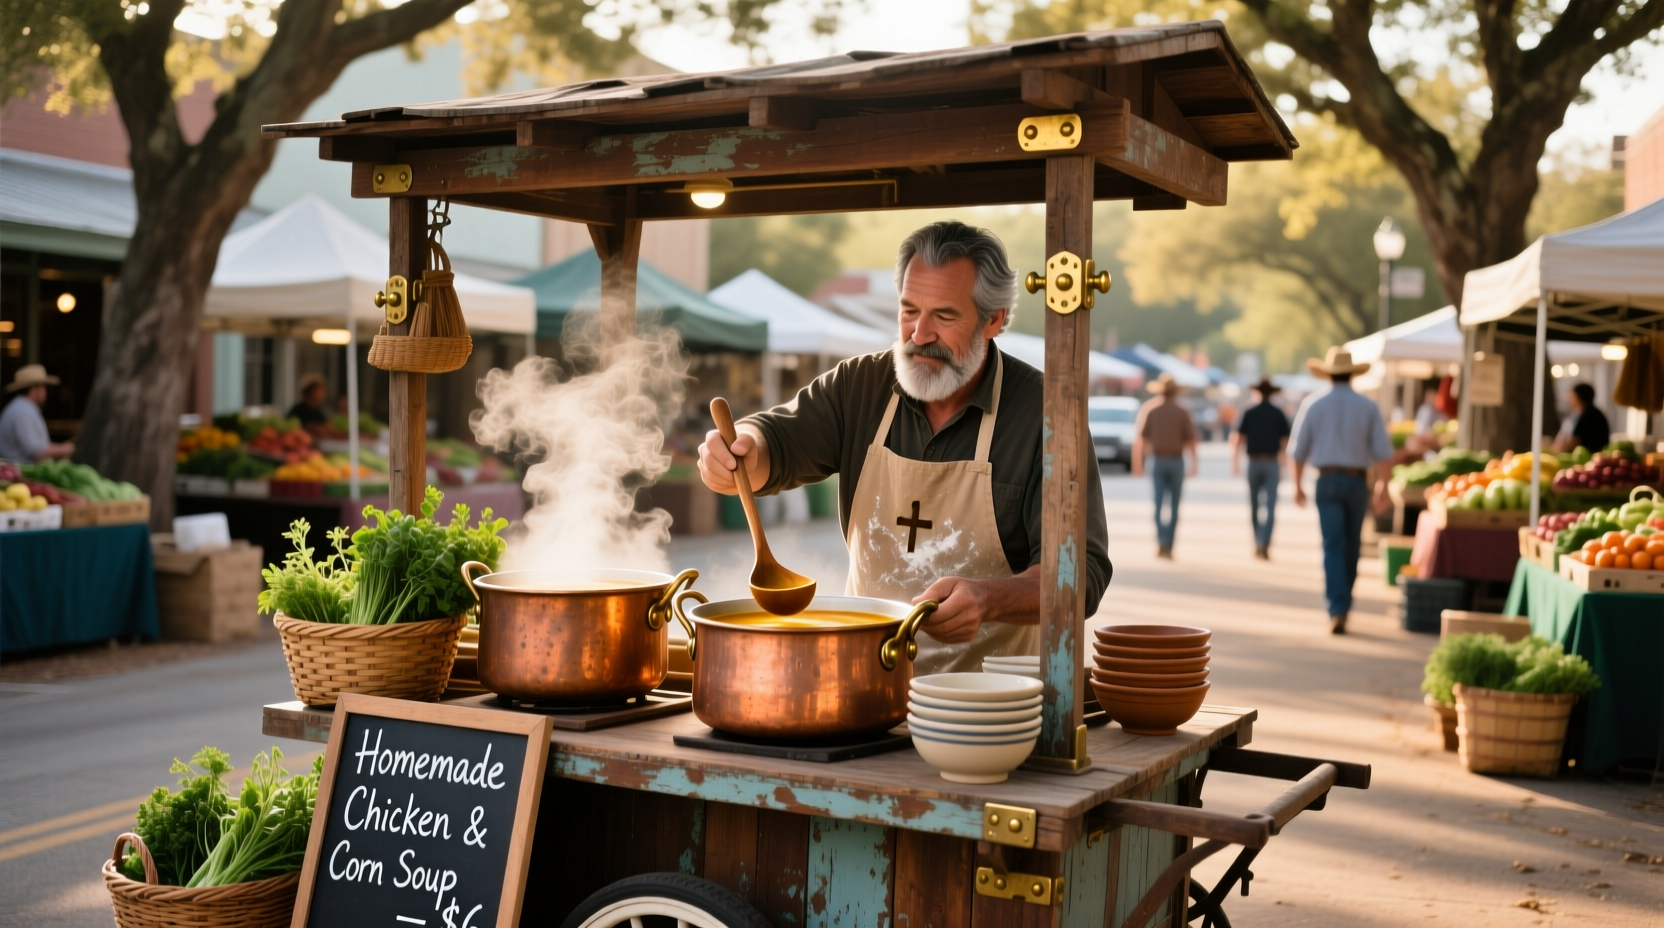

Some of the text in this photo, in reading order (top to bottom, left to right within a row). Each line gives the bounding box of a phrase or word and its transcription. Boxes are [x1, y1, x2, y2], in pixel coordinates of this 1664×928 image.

[354, 728, 506, 790] Homemade
[343, 785, 488, 849] Chicken &
[329, 839, 458, 911] Corn Soup
